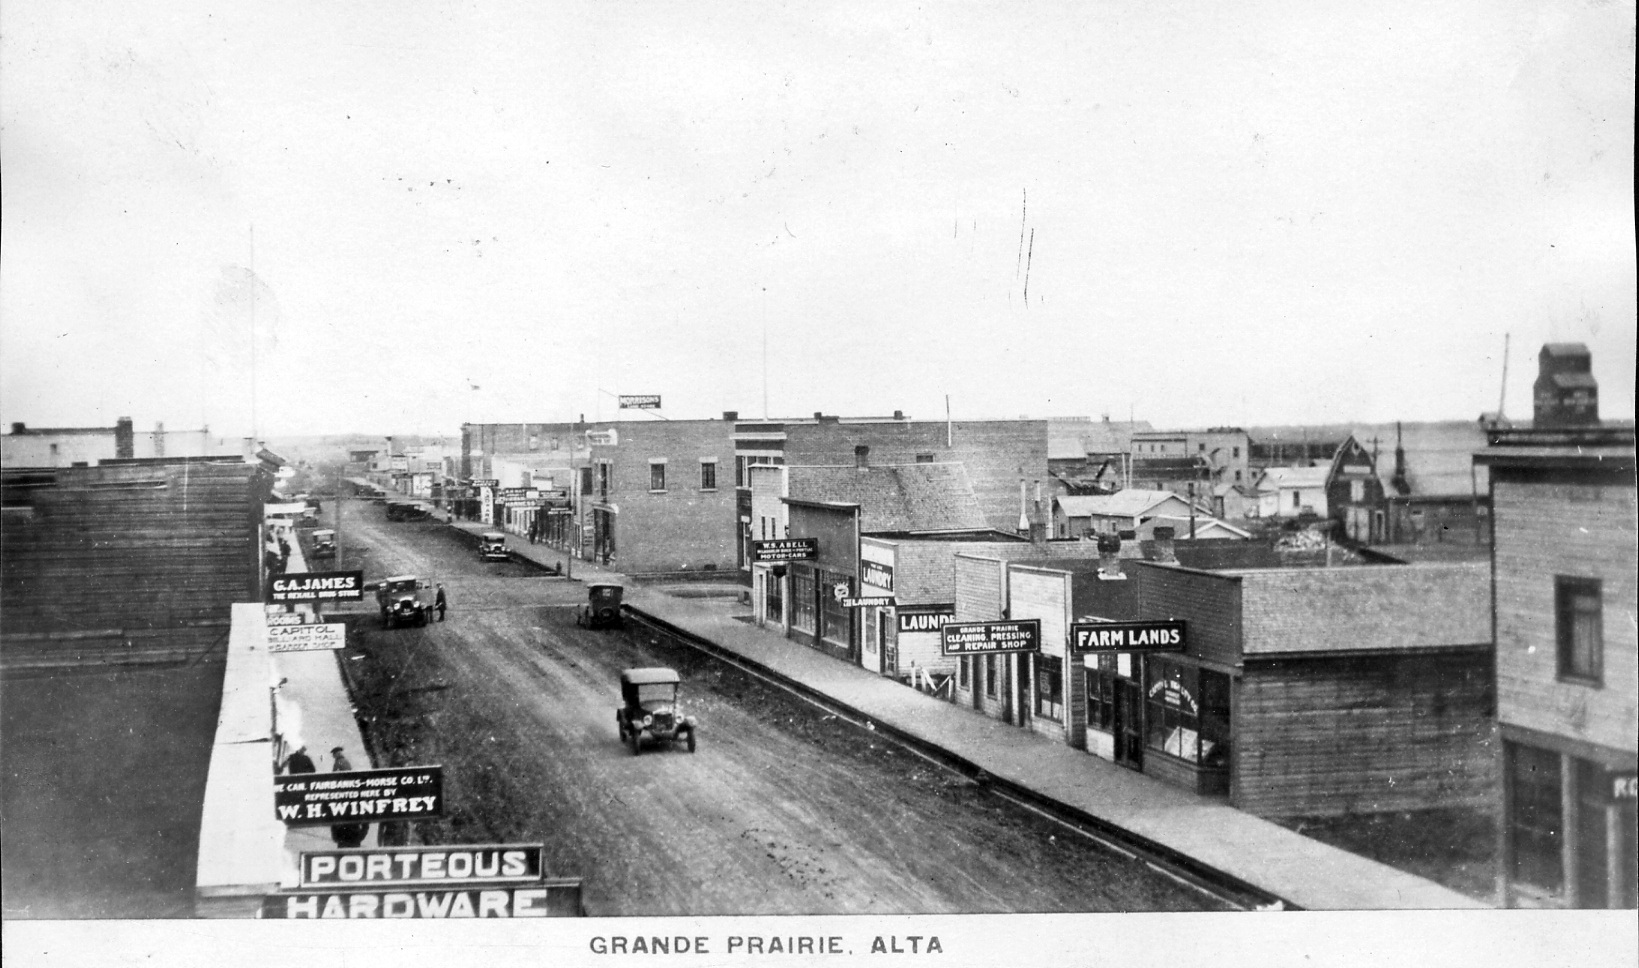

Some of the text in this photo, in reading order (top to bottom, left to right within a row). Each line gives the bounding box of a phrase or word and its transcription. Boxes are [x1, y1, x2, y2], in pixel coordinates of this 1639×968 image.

[779, 541, 808, 549] ABELL
[852, 598, 890, 606] LAUNDRY
[270, 626, 336, 636] CAPITOL
[960, 626, 986, 634] GRANDE
[1078, 628, 1180, 647] FARM LANDS
[964, 642, 997, 651] REPAIR
[1001, 640, 1026, 649] SHOP
[310, 776, 398, 790] FAIRBANKS-MORSE
[304, 788, 398, 801] REPRESENTED HERE BY
[278, 796, 437, 820] W. H. WINFREY
[310, 851, 526, 882] PORTEOUS
[286, 889, 548, 918] HARDWARE
